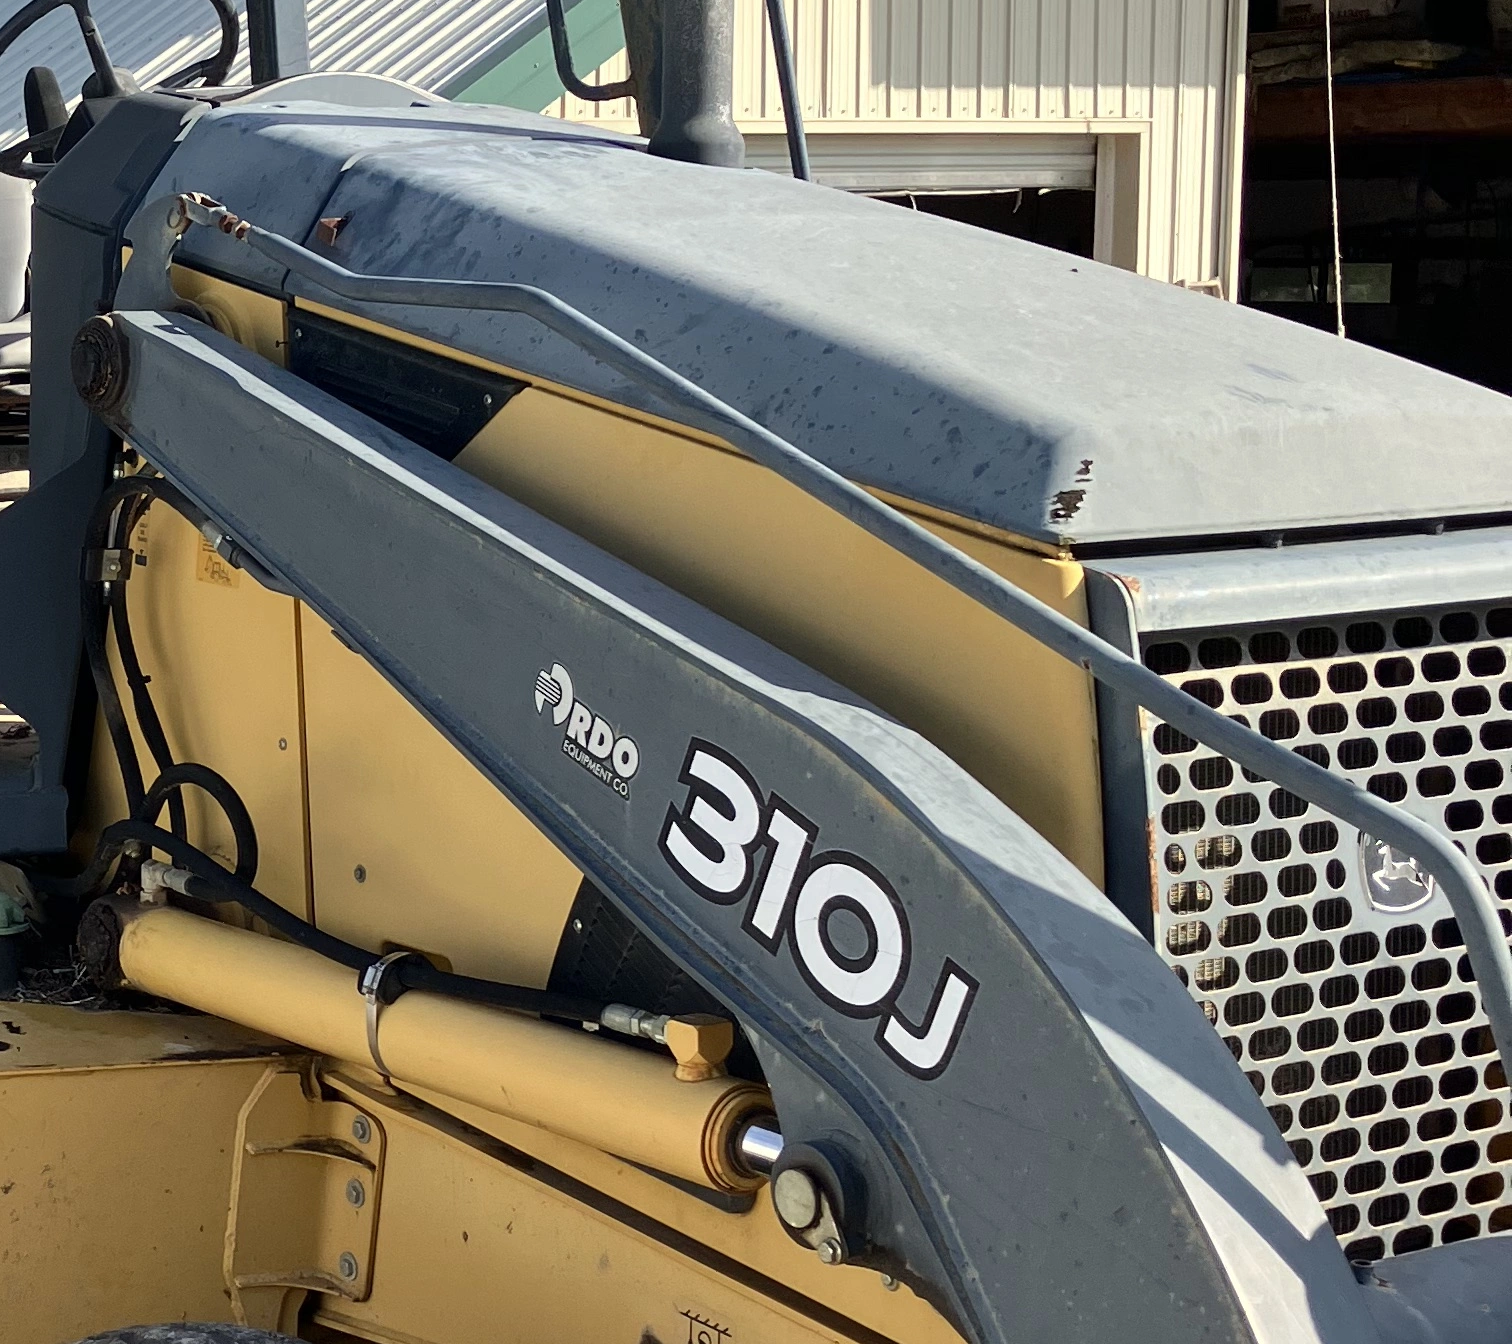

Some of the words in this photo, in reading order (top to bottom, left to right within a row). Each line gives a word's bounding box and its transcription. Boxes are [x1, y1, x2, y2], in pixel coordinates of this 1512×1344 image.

[563, 739, 613, 784] EQUIPMENT
[566, 700, 639, 778] RDO
[665, 748, 970, 1070] 310J
